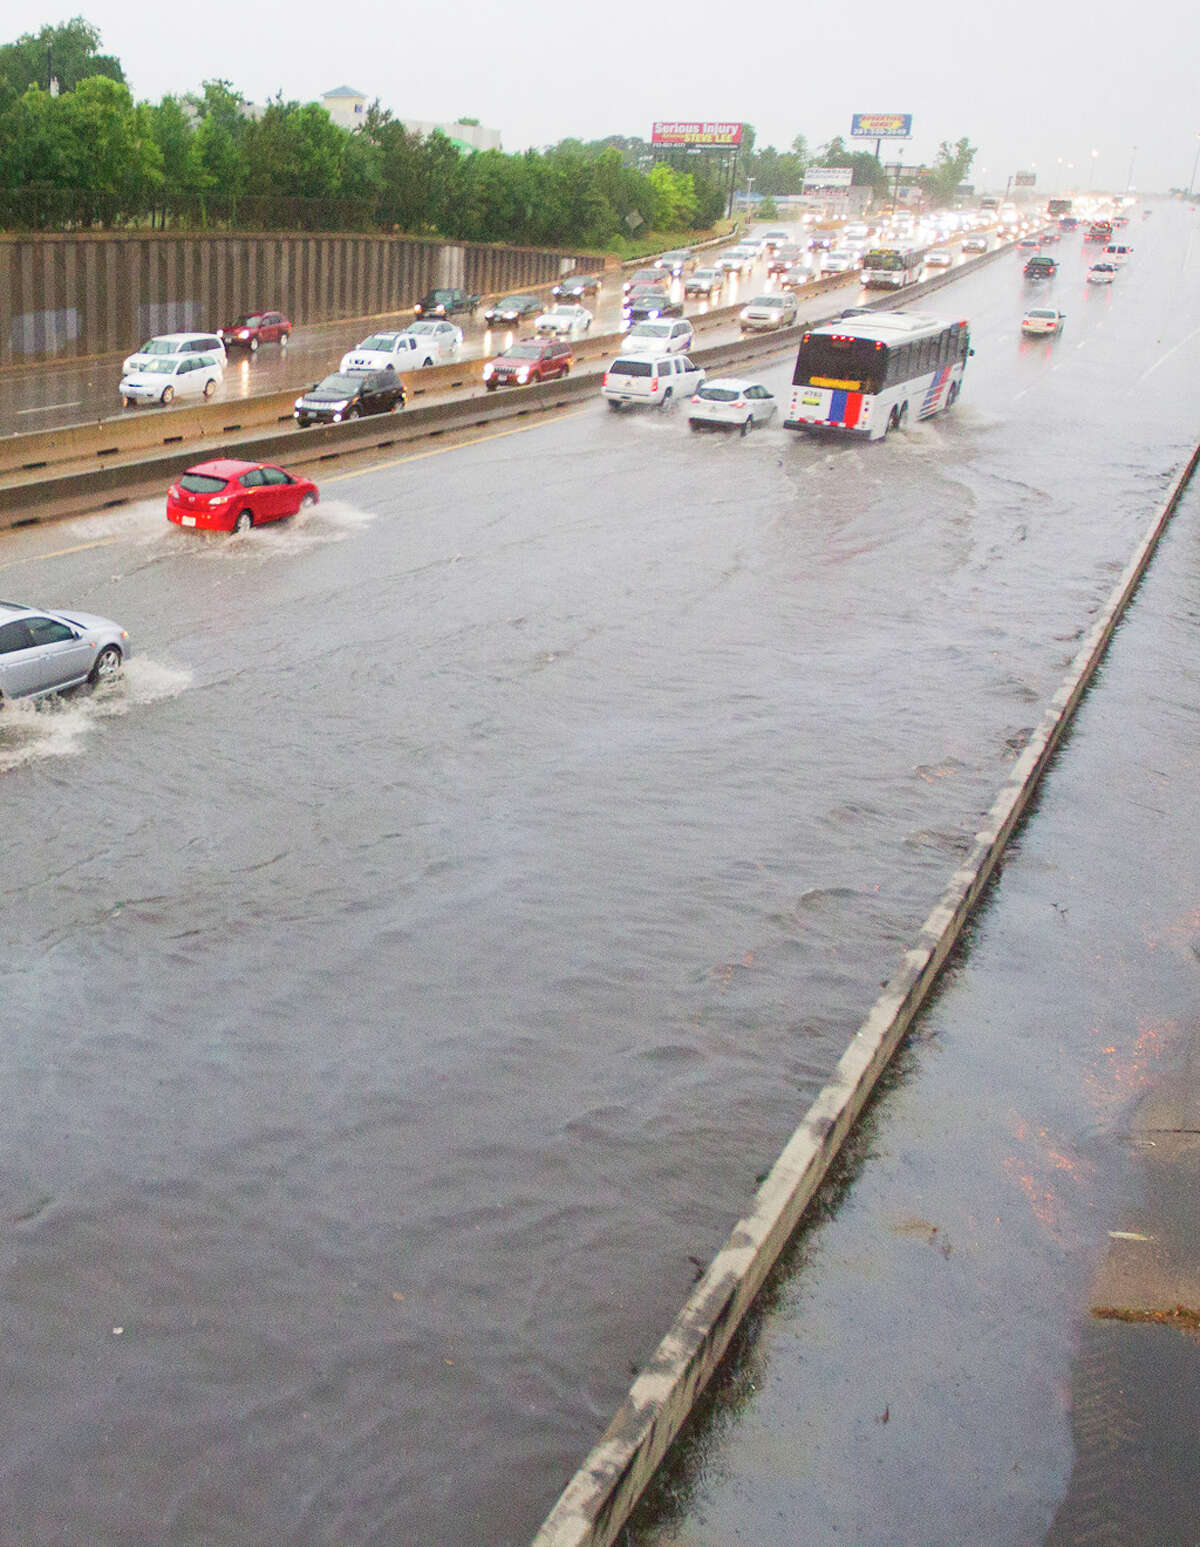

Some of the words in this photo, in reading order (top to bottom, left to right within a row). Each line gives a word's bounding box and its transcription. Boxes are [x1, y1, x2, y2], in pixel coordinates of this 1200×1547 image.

[655, 122, 700, 134] Serious
[703, 122, 738, 136] Injury
[684, 133, 713, 143] STEVE
[715, 133, 733, 143] LEE
